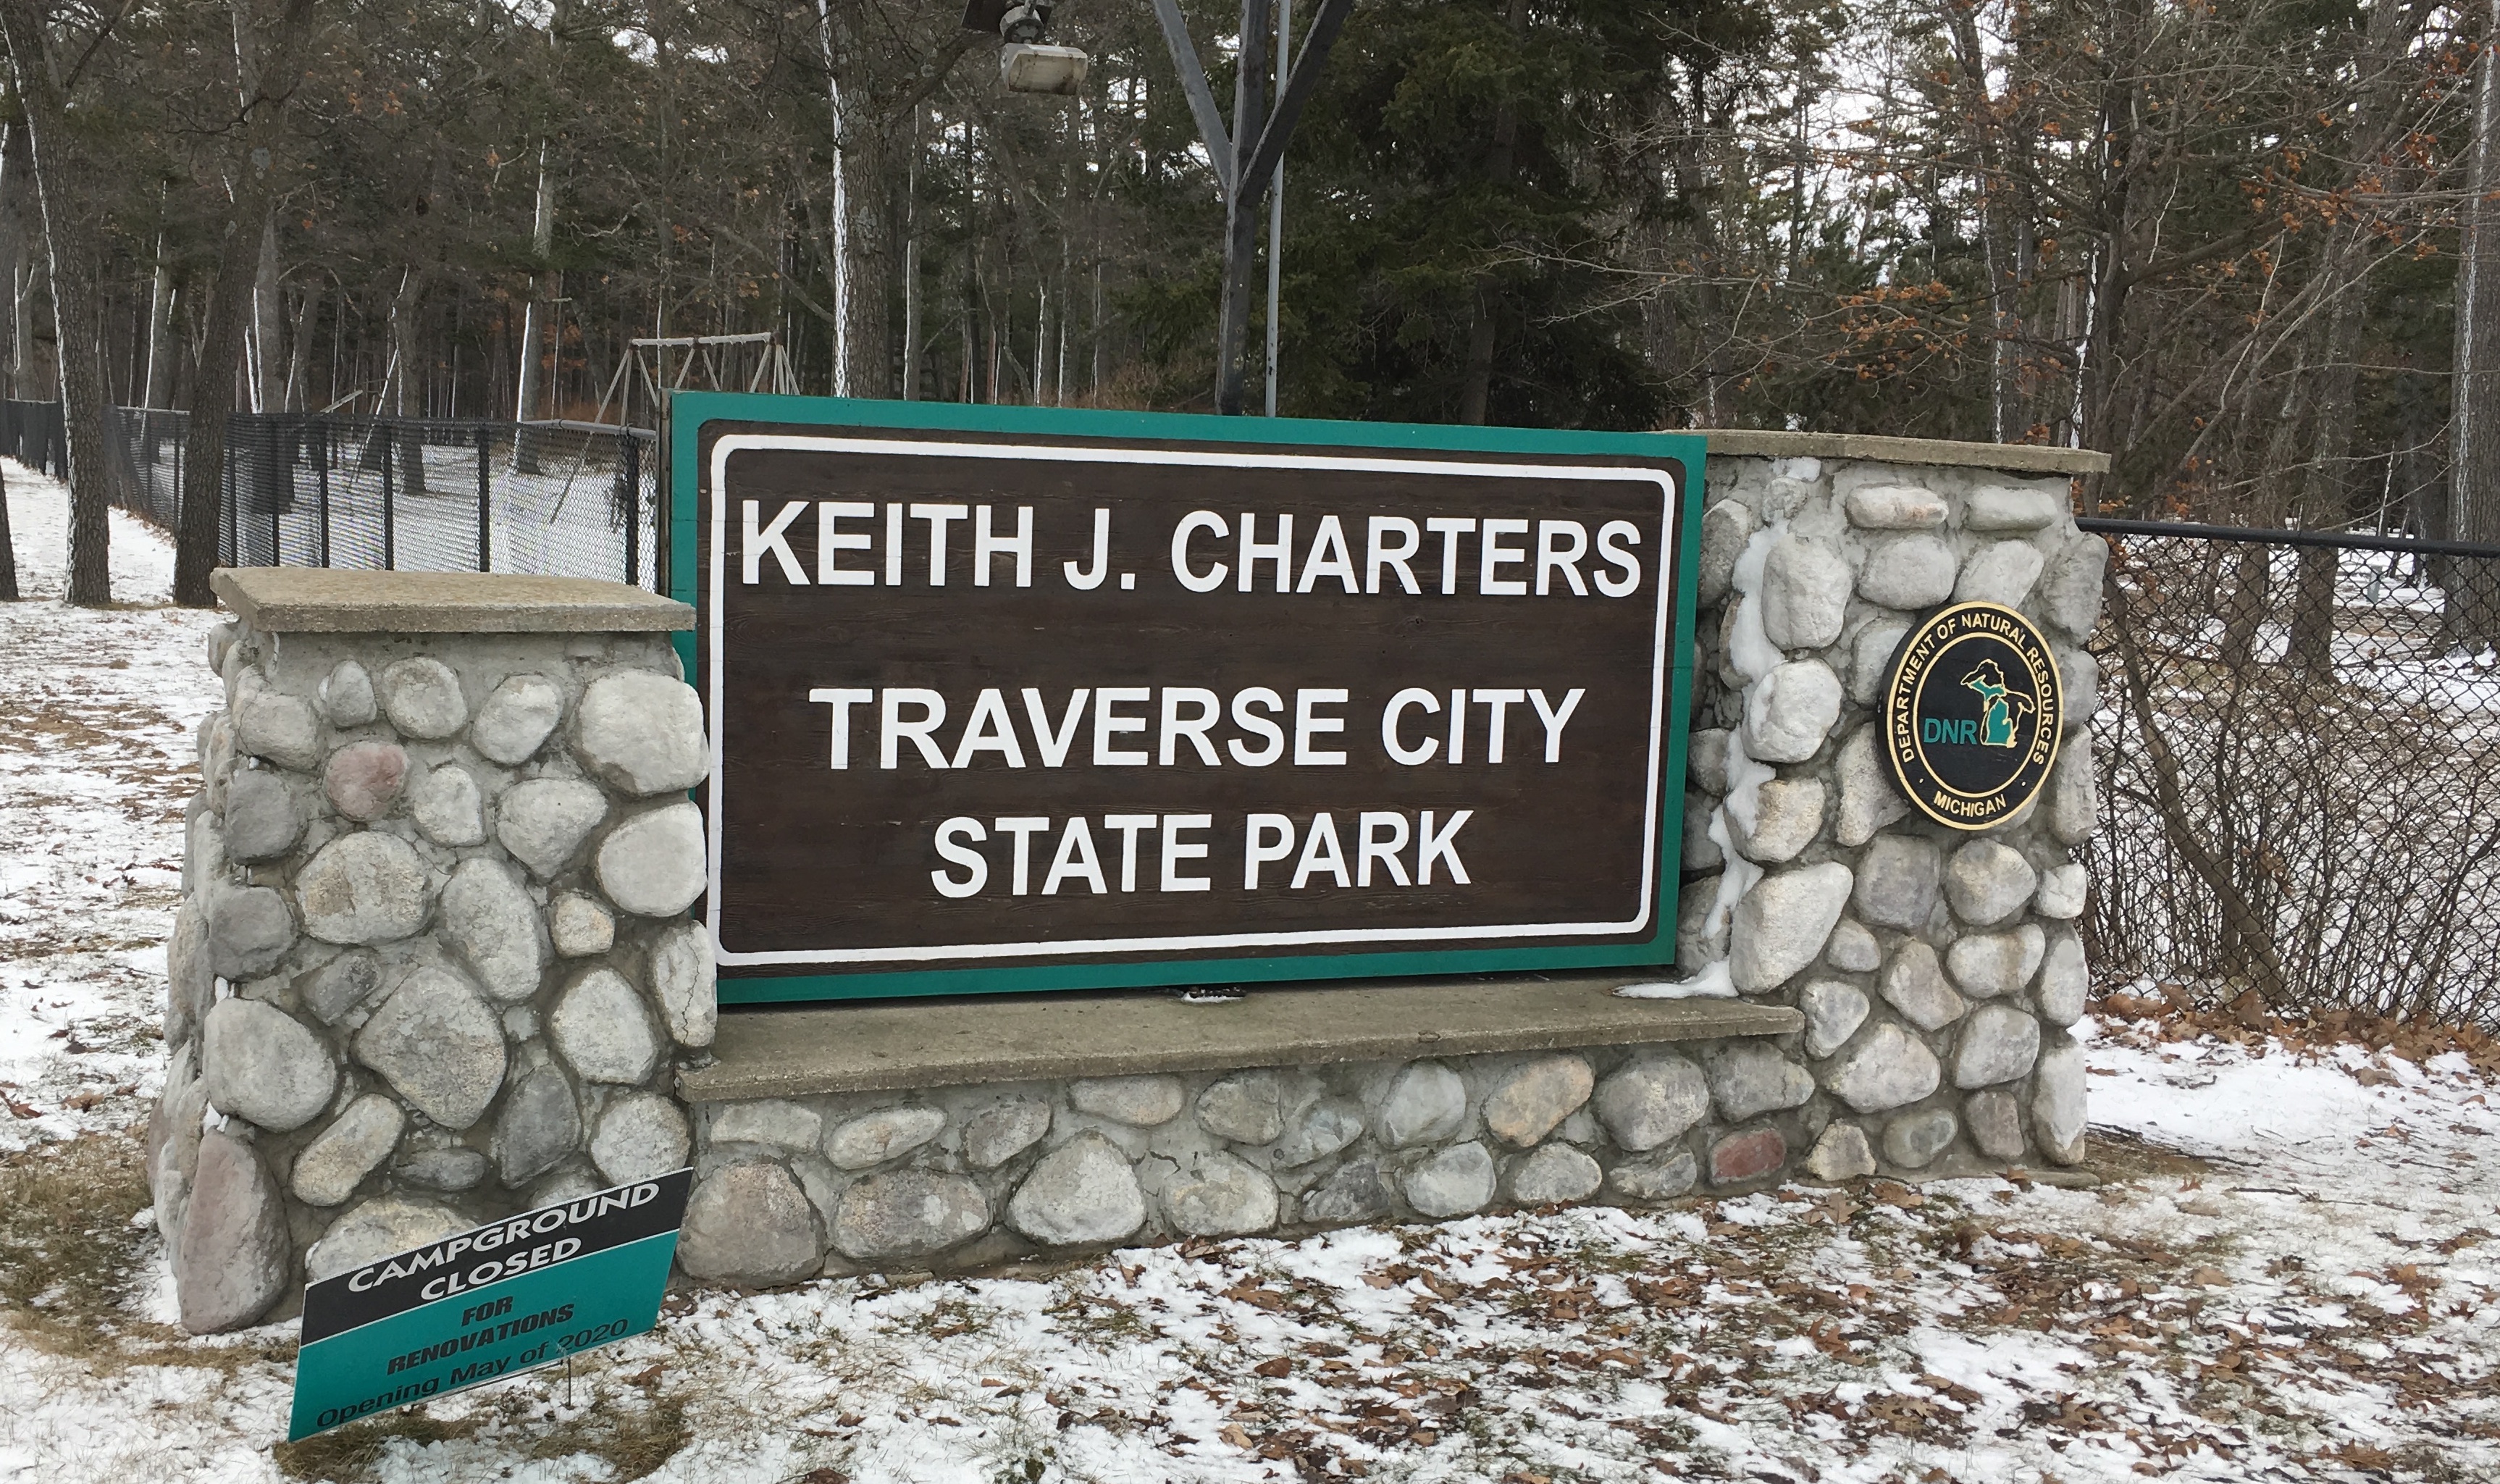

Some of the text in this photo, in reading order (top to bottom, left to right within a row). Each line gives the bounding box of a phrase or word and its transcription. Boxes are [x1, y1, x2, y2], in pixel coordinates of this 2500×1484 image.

[743, 500, 1640, 597] KEITH J. CHARTERS
[809, 687, 1585, 769] TRAVERSE CITY
[1896, 613, 2054, 765] DEPARTMENT OF NATURAL RESOURCES
[1924, 718, 1977, 745] DNR
[1934, 791, 2006, 817] MICHIGAN
[931, 810, 1474, 897] STATE PARK
[348, 1183, 660, 1293] CAMPGROUND
[421, 1237, 582, 1301] CLOSED
[387, 1304, 574, 1375] RENOVATIONS
[461, 1296, 513, 1327] FOR
[316, 1319, 629, 1428] Opening May of 2020
